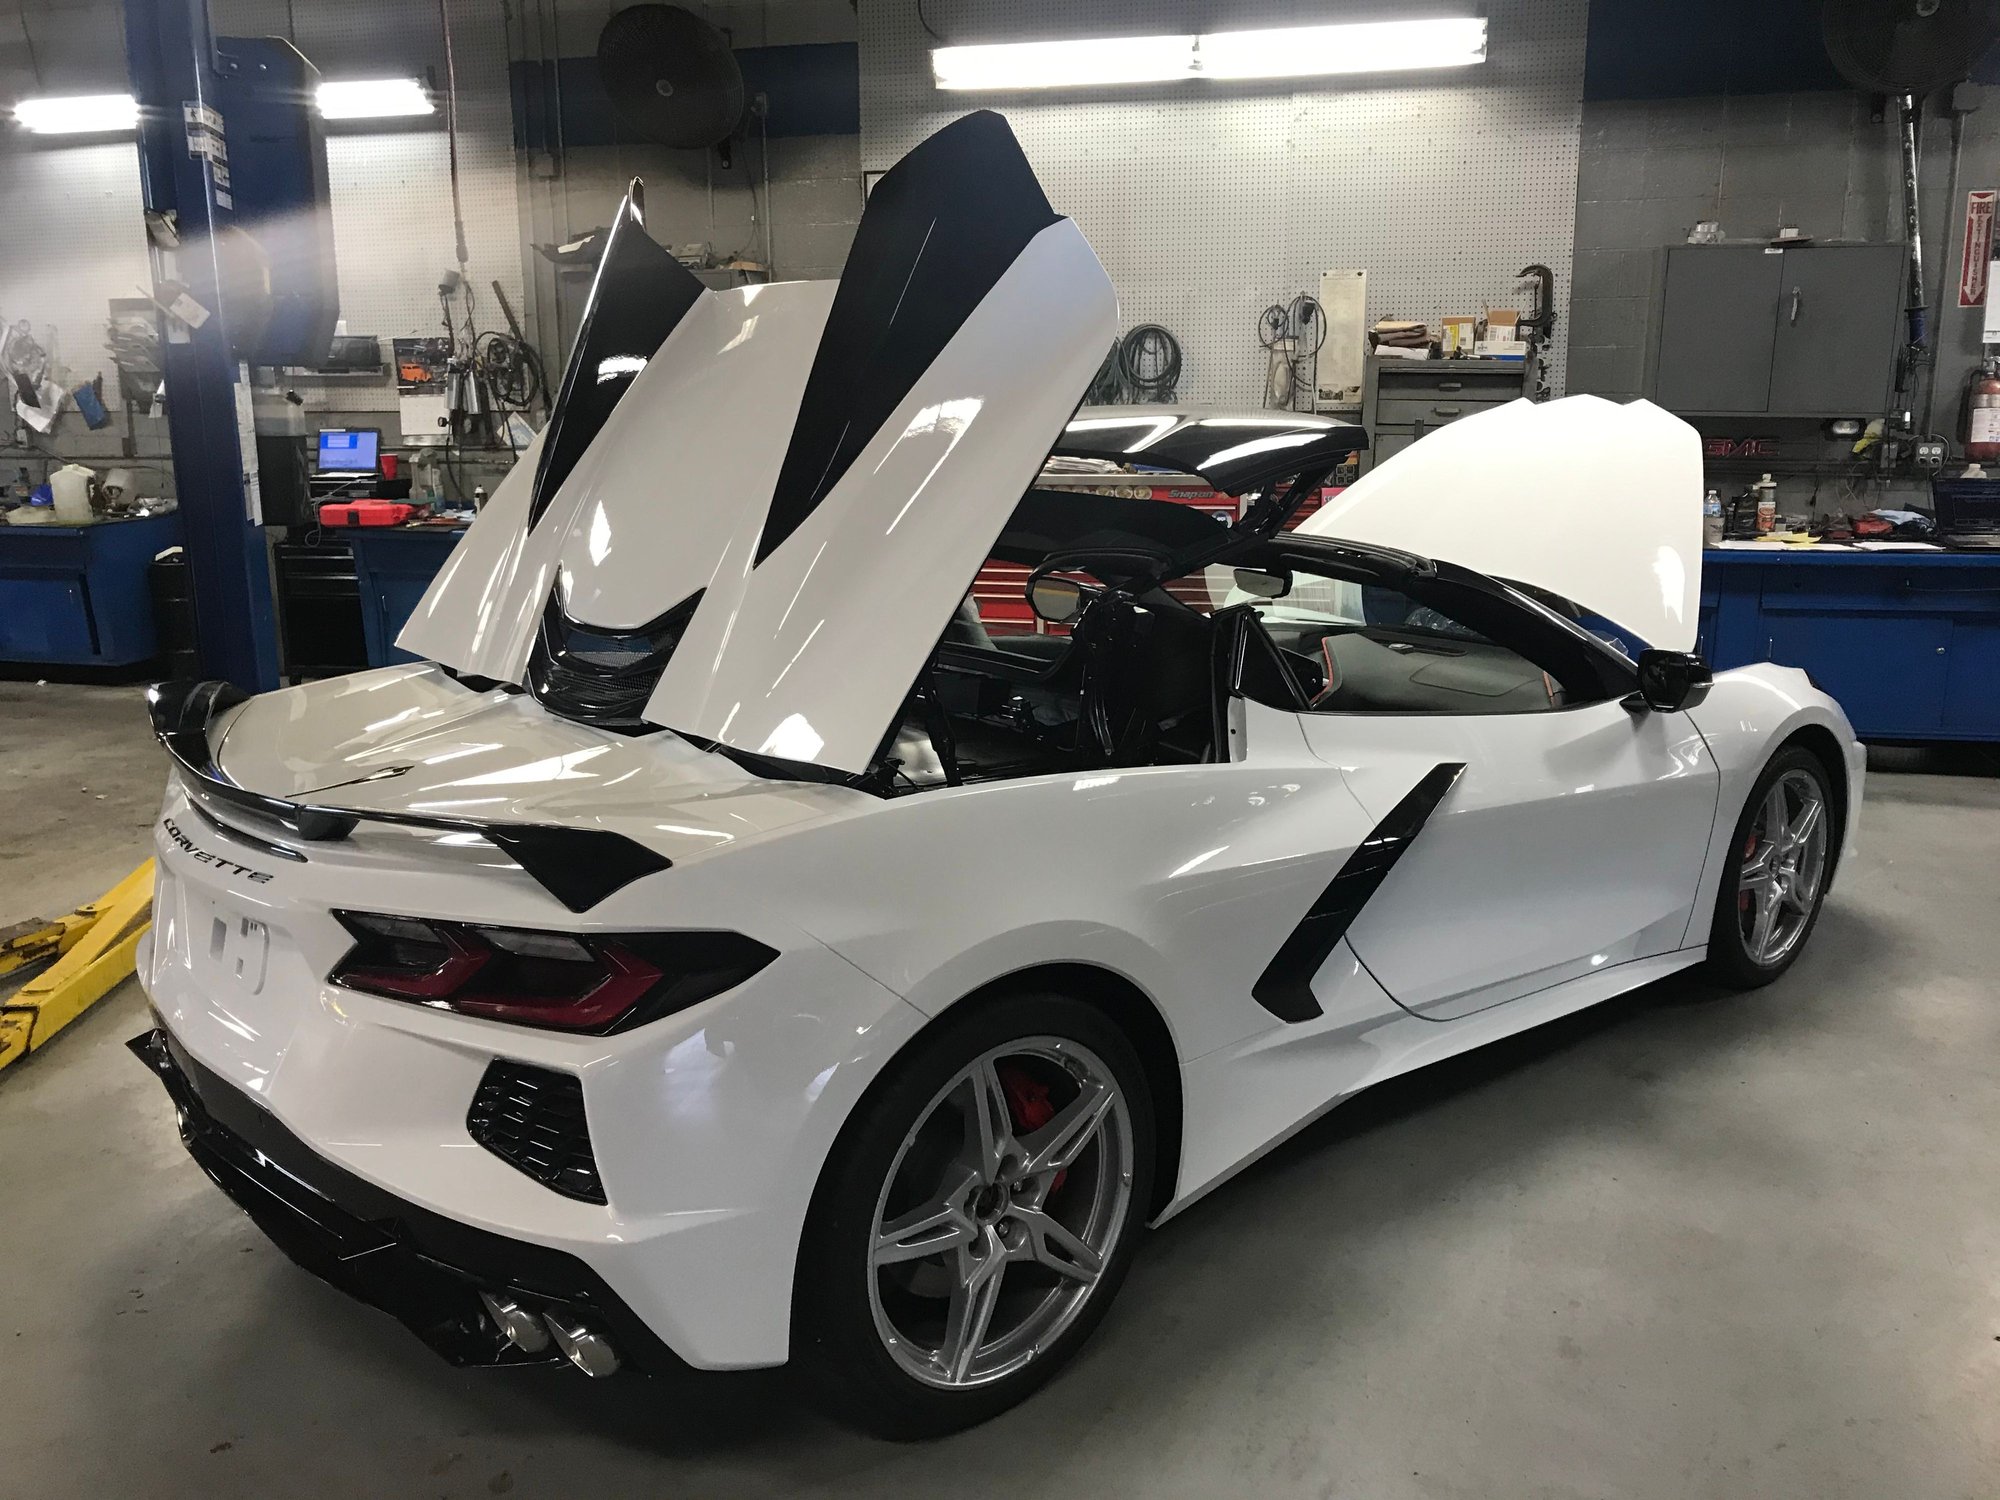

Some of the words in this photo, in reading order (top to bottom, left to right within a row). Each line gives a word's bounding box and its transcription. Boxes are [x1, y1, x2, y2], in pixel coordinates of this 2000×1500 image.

[1971, 202, 1992, 214] FIRE
[1970, 215, 1983, 295] EXTINGUISHER
[1705, 438, 1780, 456] GMC
[163, 818, 274, 884] CORVETTE
